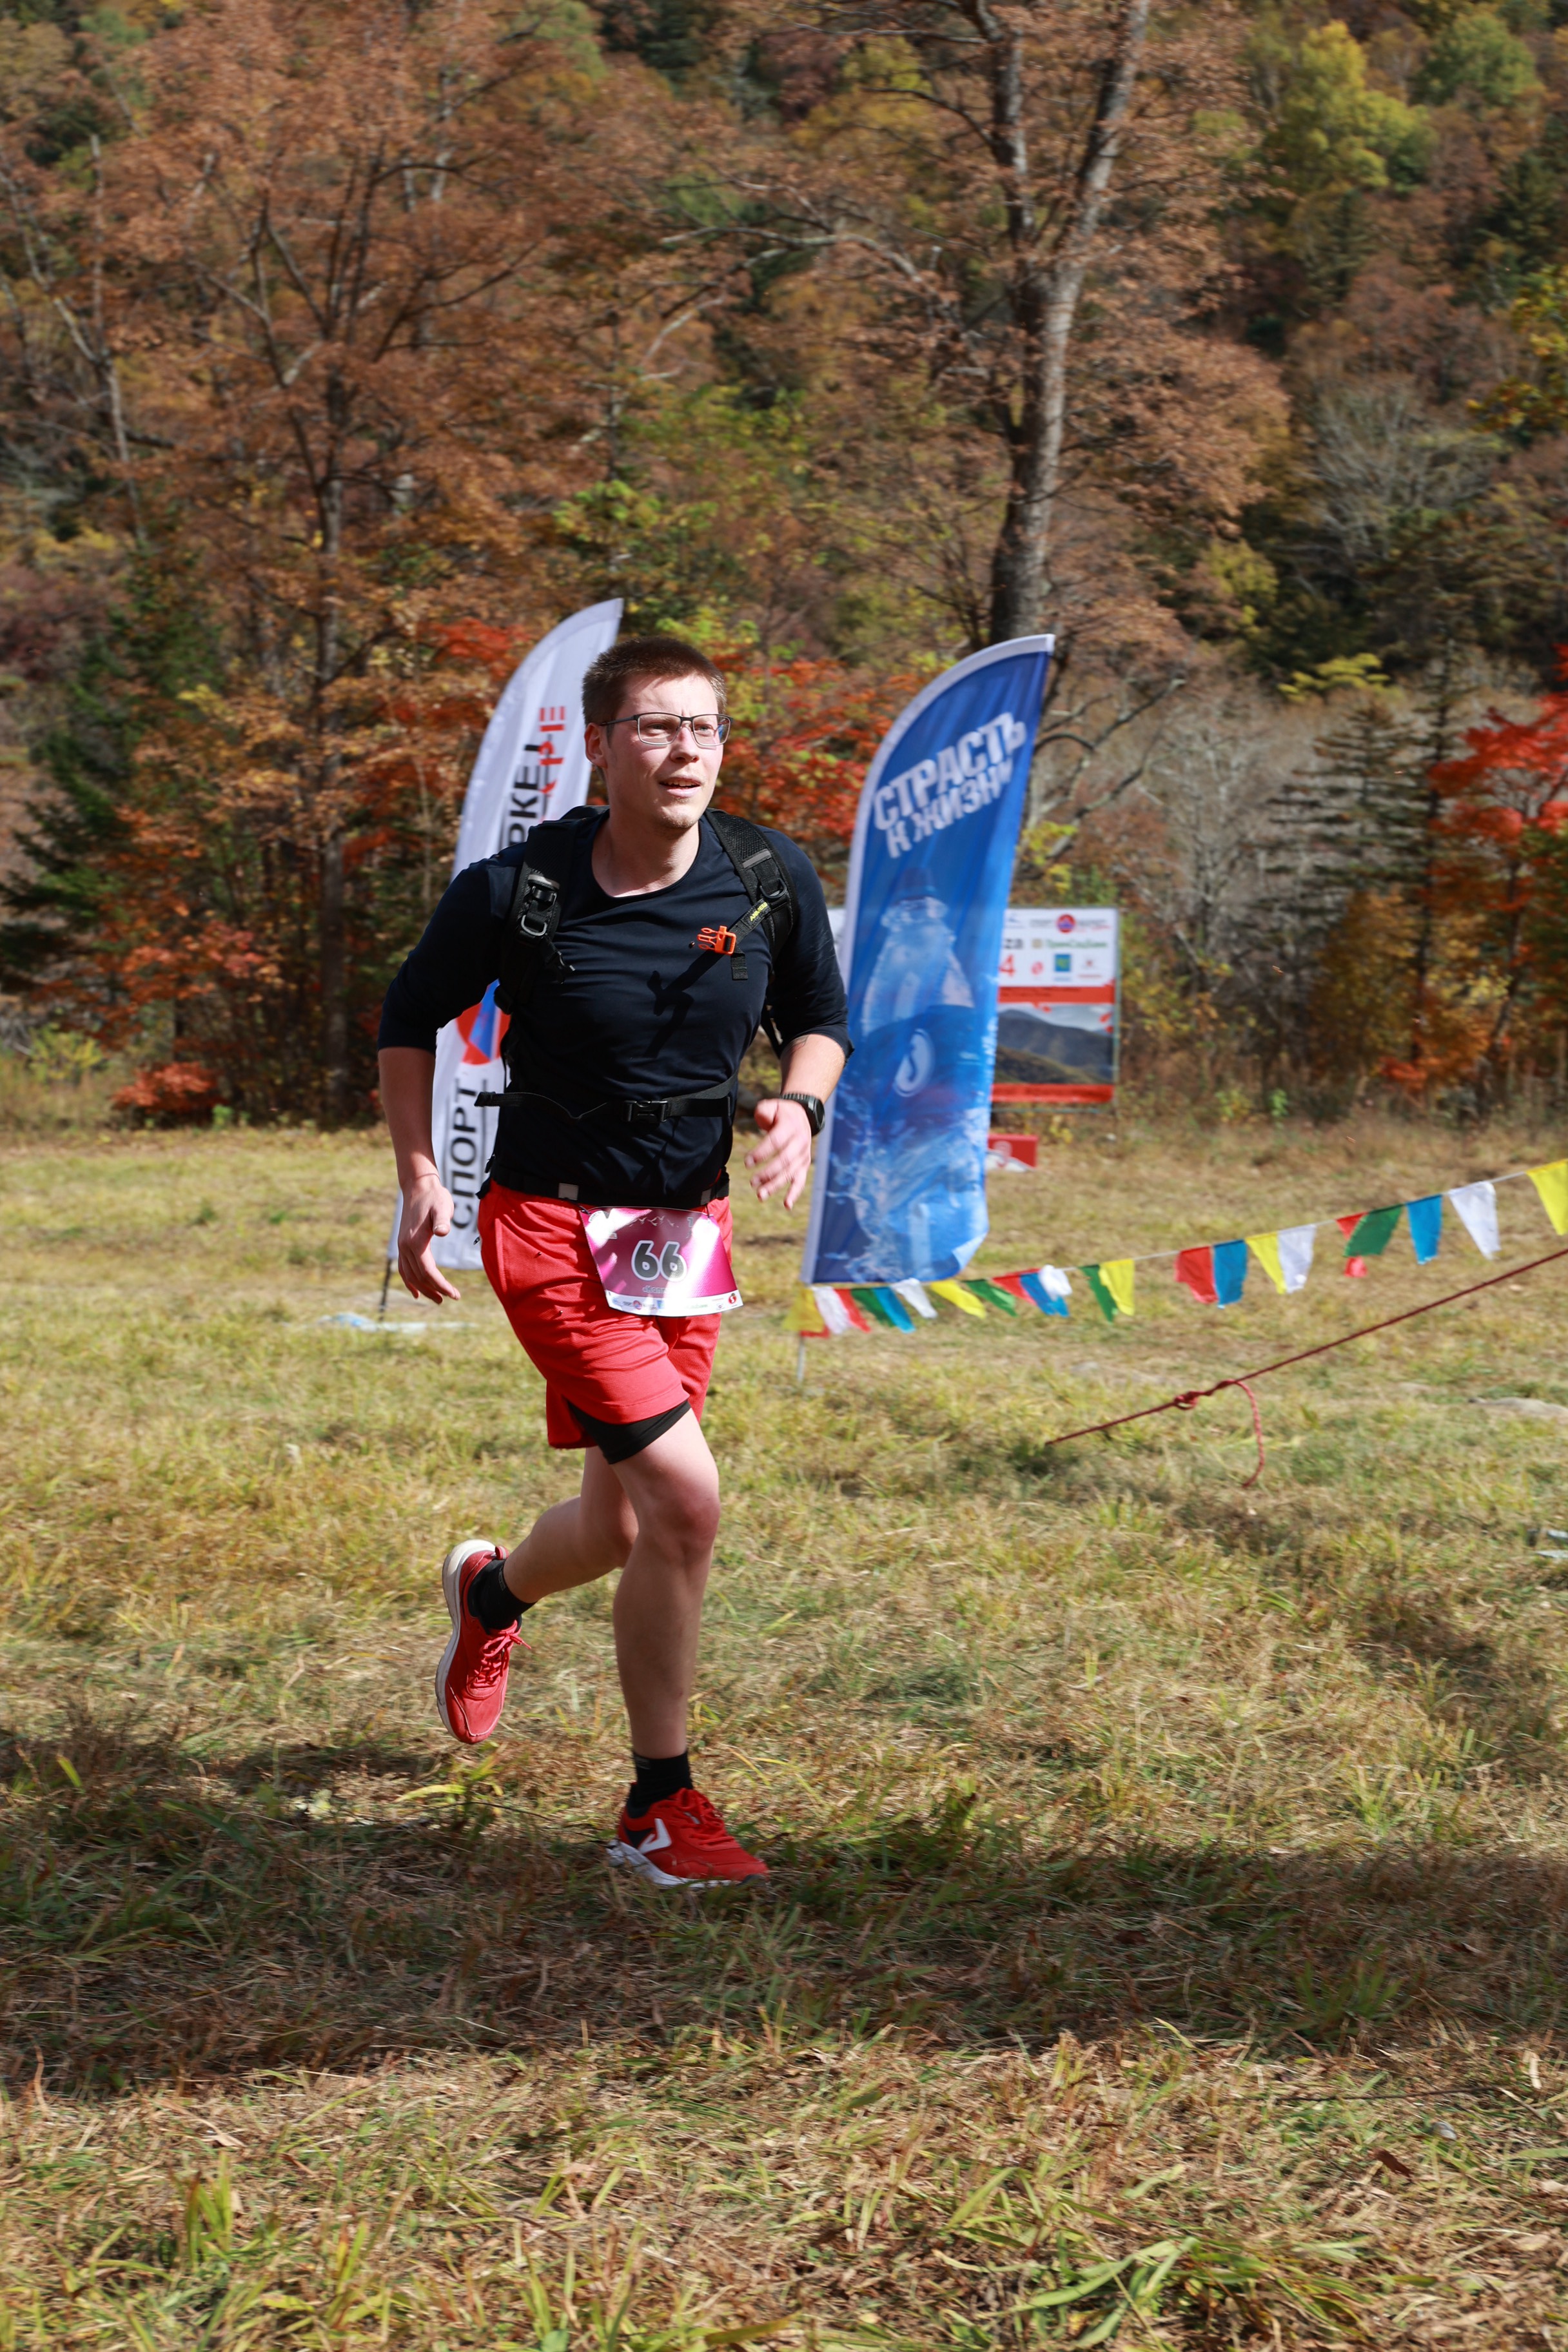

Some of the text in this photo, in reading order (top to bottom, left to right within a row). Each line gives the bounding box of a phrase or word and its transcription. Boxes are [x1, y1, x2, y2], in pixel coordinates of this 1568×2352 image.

[874, 712, 1027, 830] СТРАСТЬ
[912, 759, 1014, 843] ЖИЗНИ
[451, 1078, 478, 1230] СПОРТ
[631, 1239, 688, 1282] 66
